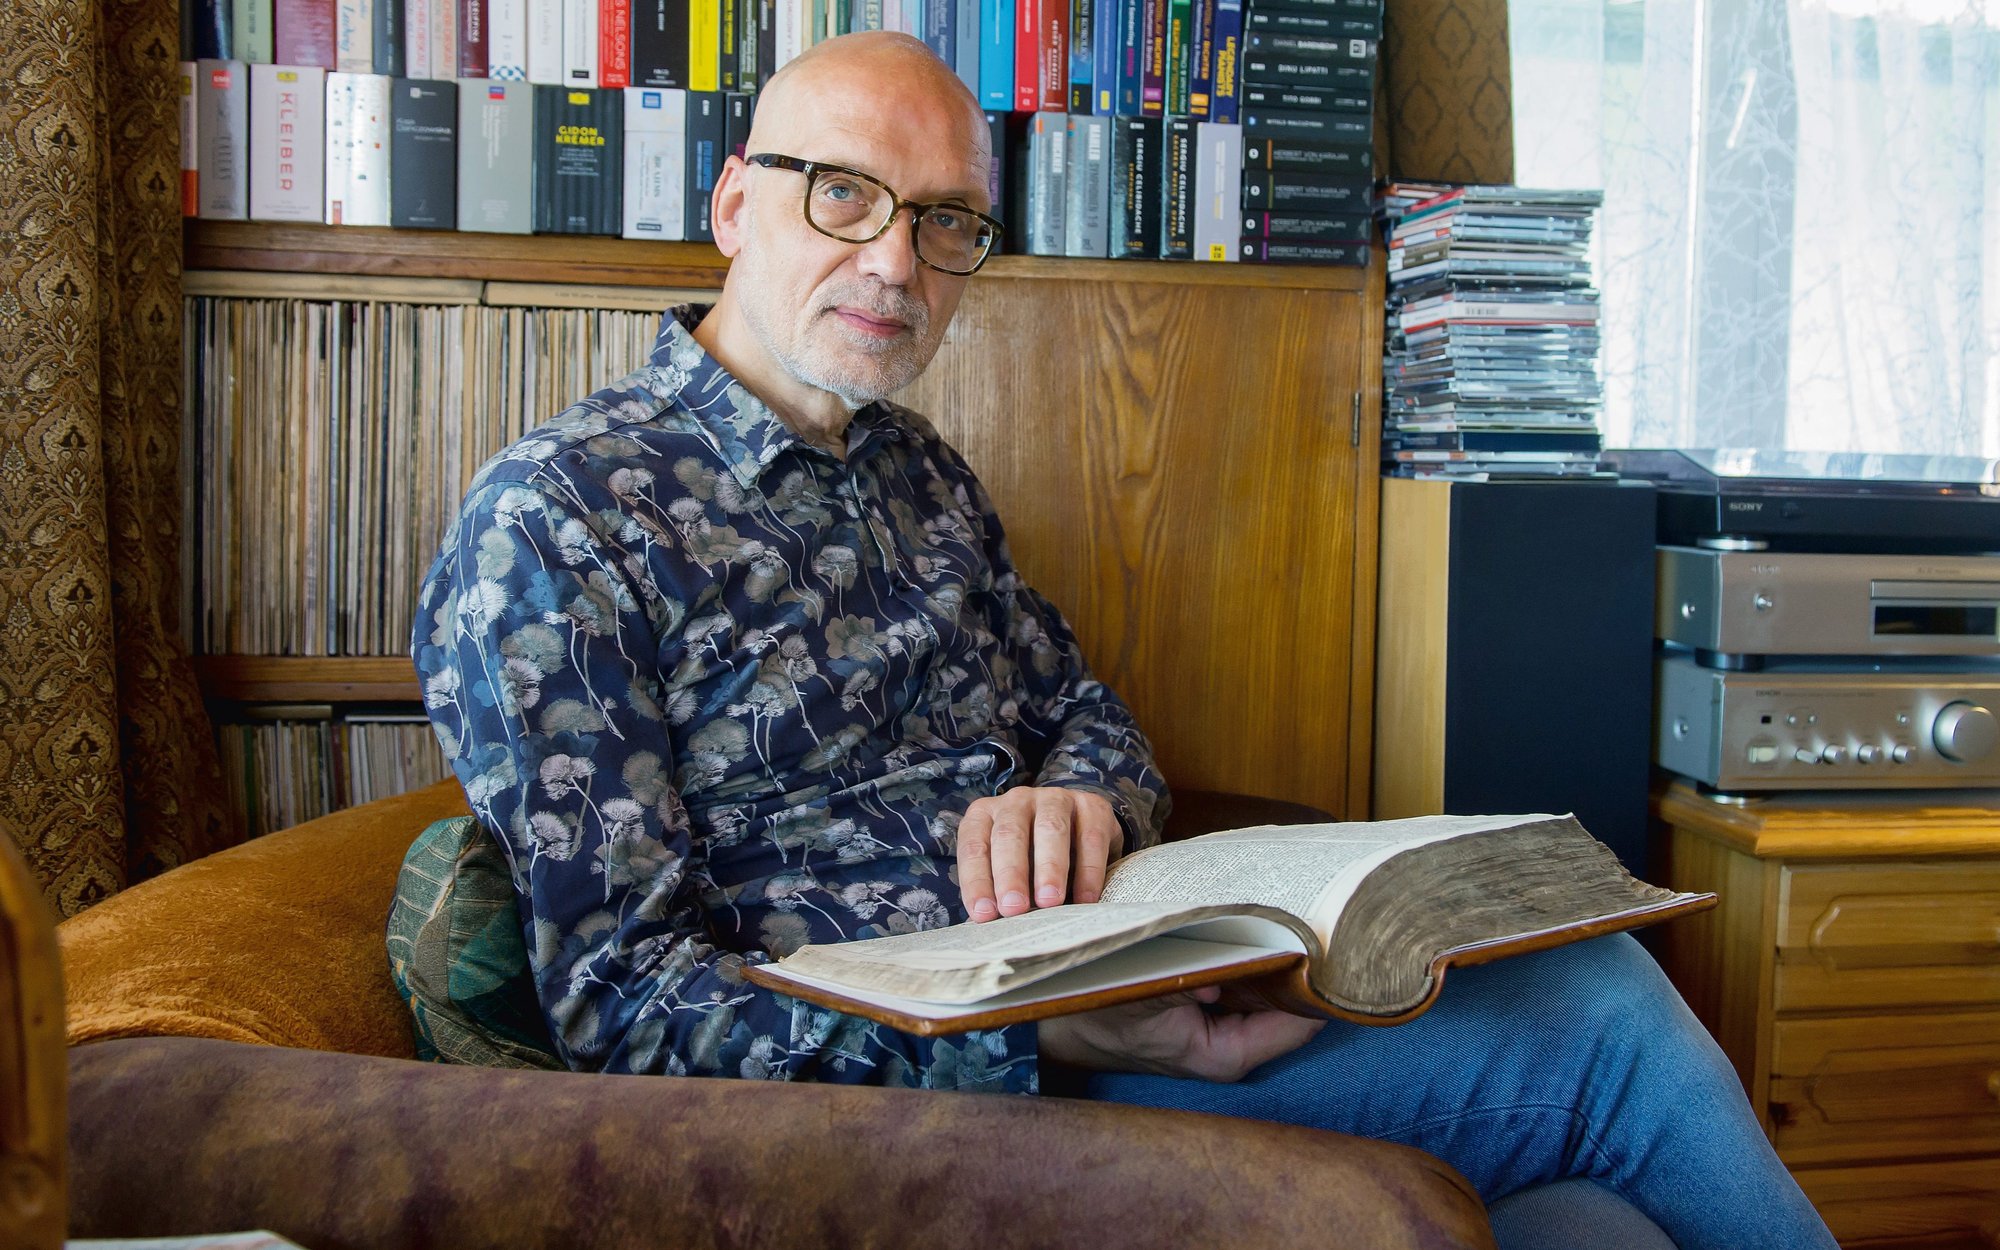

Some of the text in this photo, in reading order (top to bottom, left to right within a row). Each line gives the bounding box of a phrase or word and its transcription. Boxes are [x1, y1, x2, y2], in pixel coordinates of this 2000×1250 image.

[615, 9, 626, 70] NELSONS
[1226, 36, 1236, 97] LEGENDARY
[280, 92, 293, 190] KLEIBER
[555, 134, 606, 146] KREMER
[558, 125, 598, 136] GIDON
[1135, 138, 1144, 235] SERGIU CELIBIDACHE
[1178, 138, 1188, 235] SERGIU CELIBIDACHE
[1729, 503, 1763, 511] SONY
